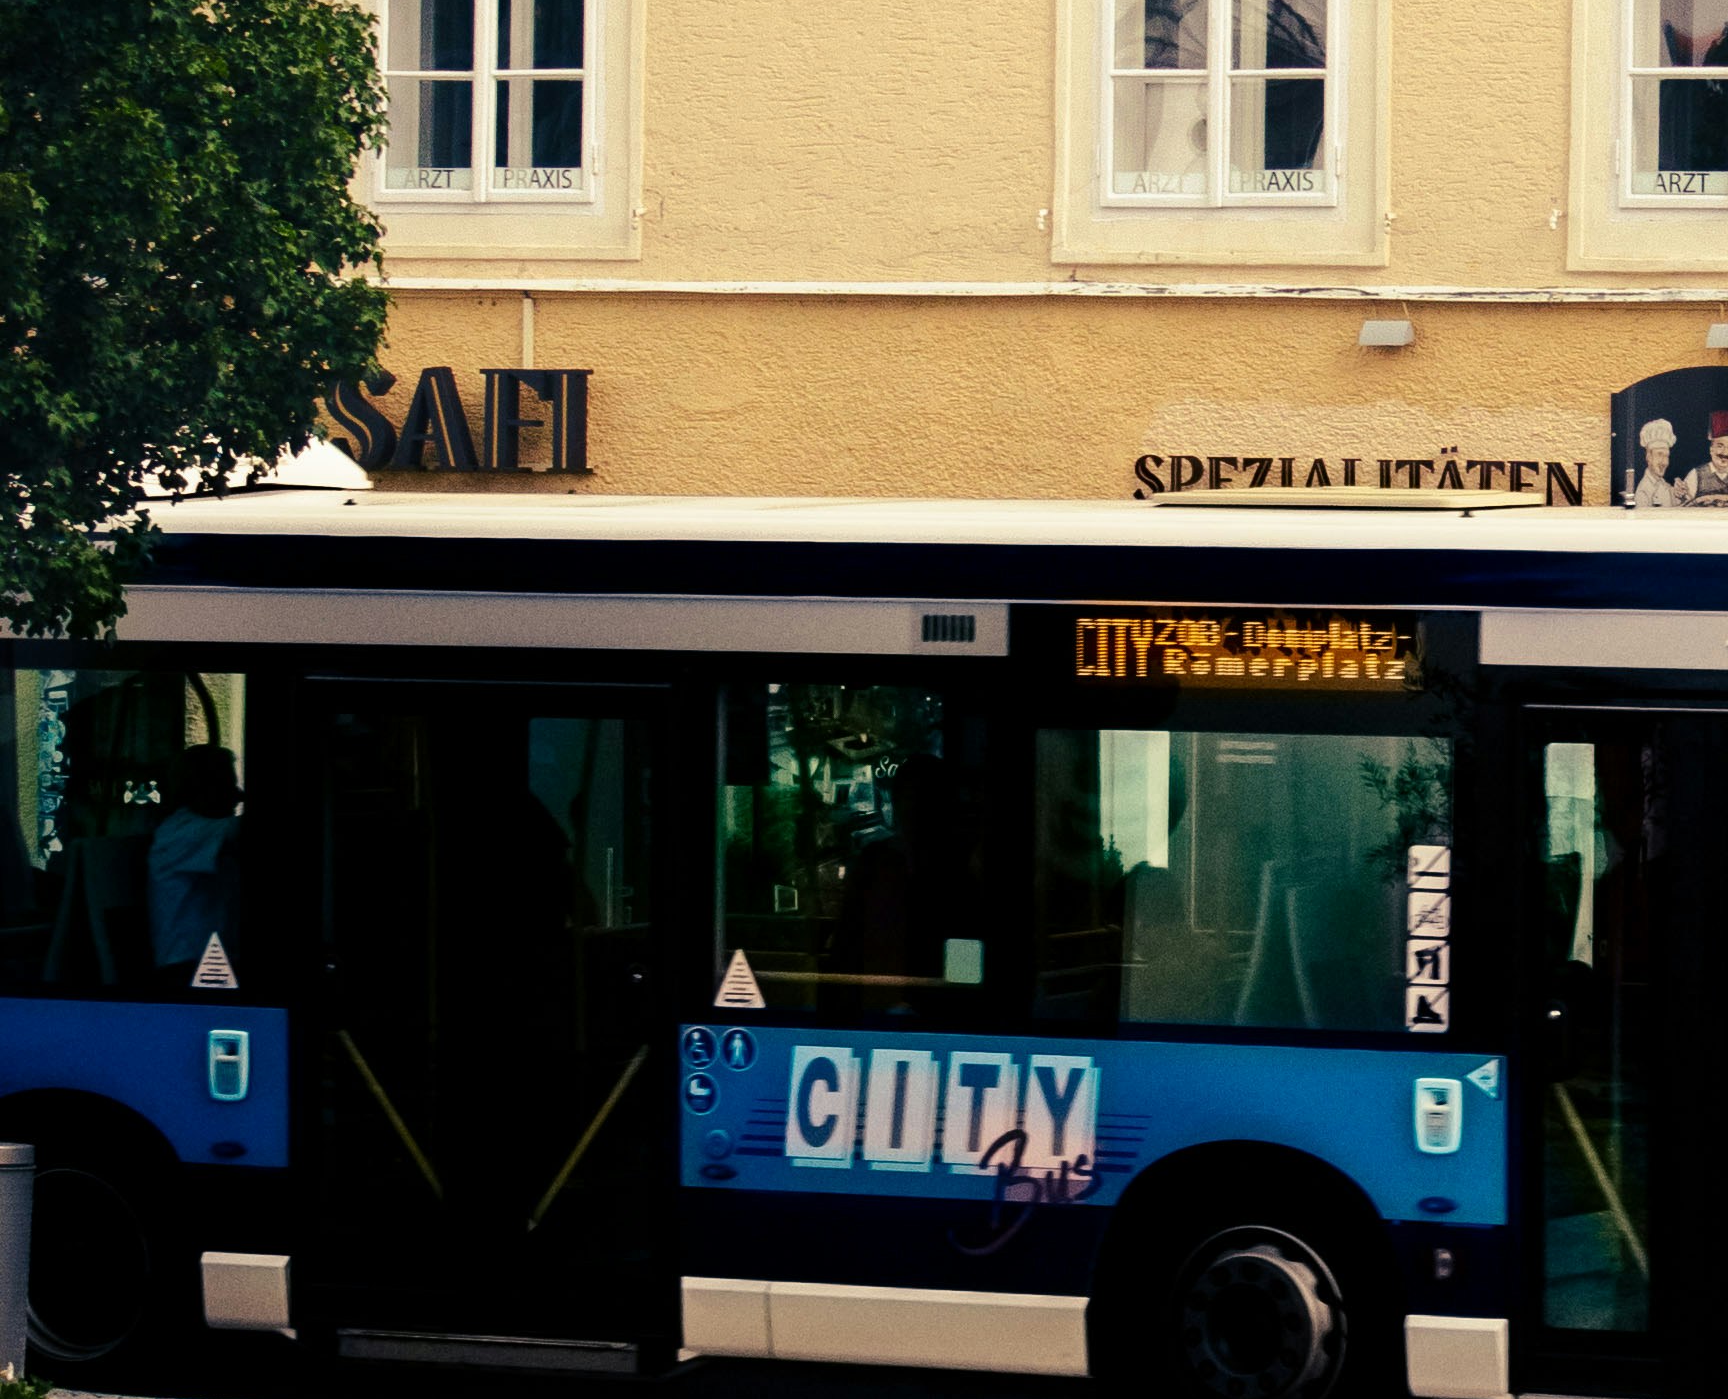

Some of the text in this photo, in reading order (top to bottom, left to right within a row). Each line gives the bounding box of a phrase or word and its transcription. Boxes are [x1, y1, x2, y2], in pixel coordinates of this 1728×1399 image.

[403, 169, 572, 190] ARZT PRAXIS
[1132, 170, 1314, 194] ARZT PRAXIS
[1654, 172, 1710, 194] ARZT
[324, 365, 594, 473] SAFI
[1076, 618, 1154, 677] CITY
[797, 1056, 1088, 1157] CITY
